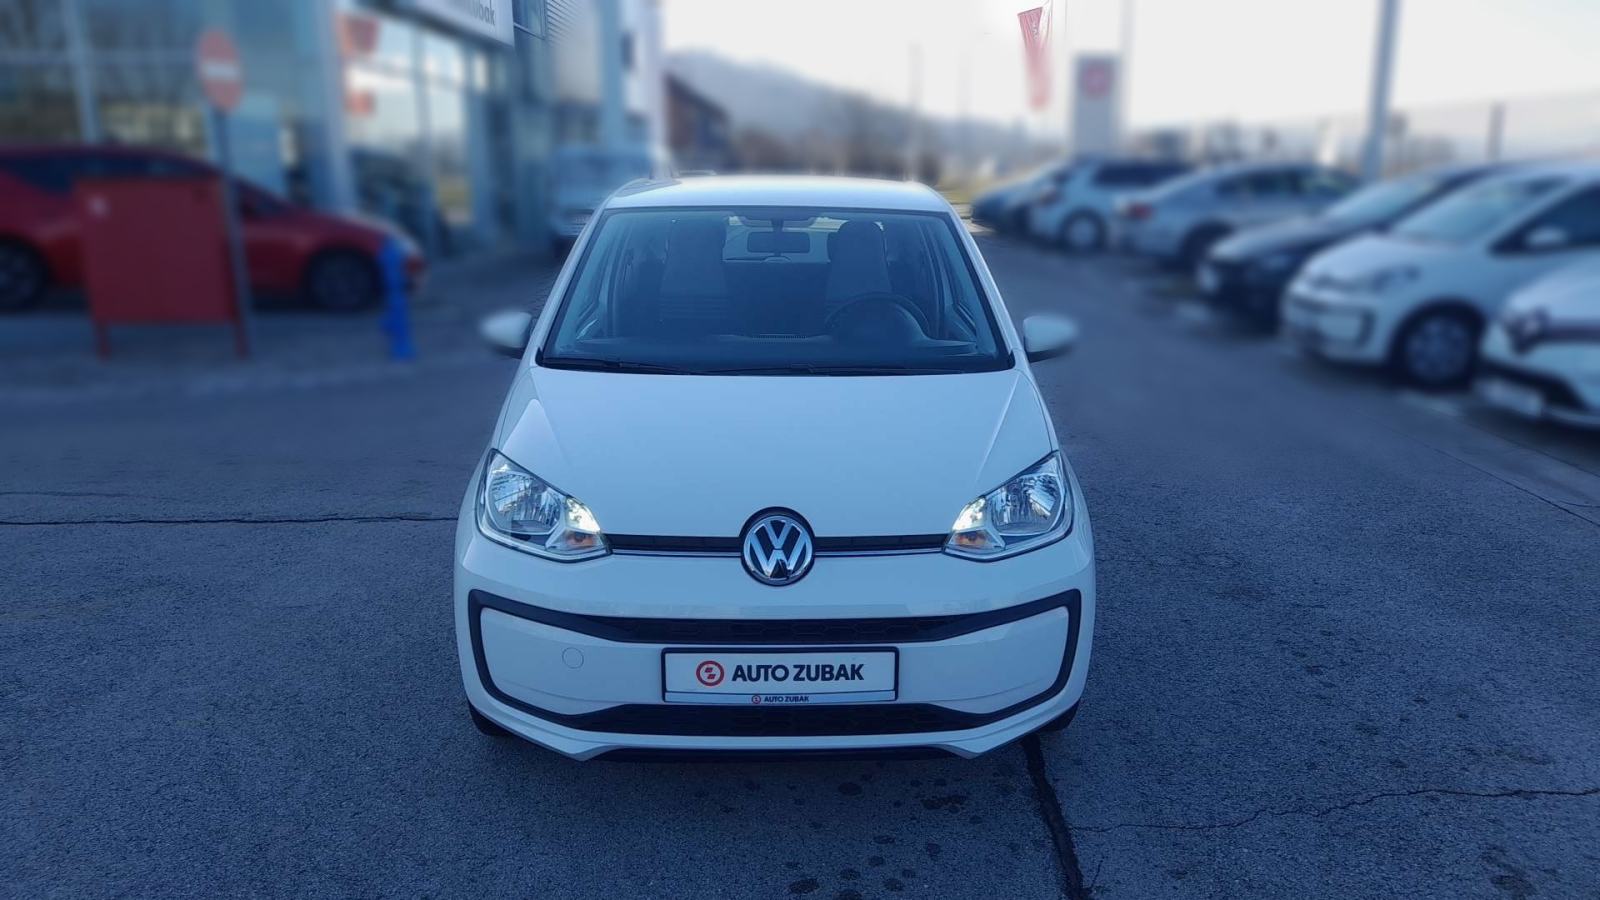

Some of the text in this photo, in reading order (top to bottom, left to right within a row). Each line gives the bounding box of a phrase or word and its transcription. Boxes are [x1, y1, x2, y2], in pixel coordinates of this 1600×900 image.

[731, 663, 865, 682] AUTO ZUBAK
[763, 695, 810, 703] AUTO ZUBAK
